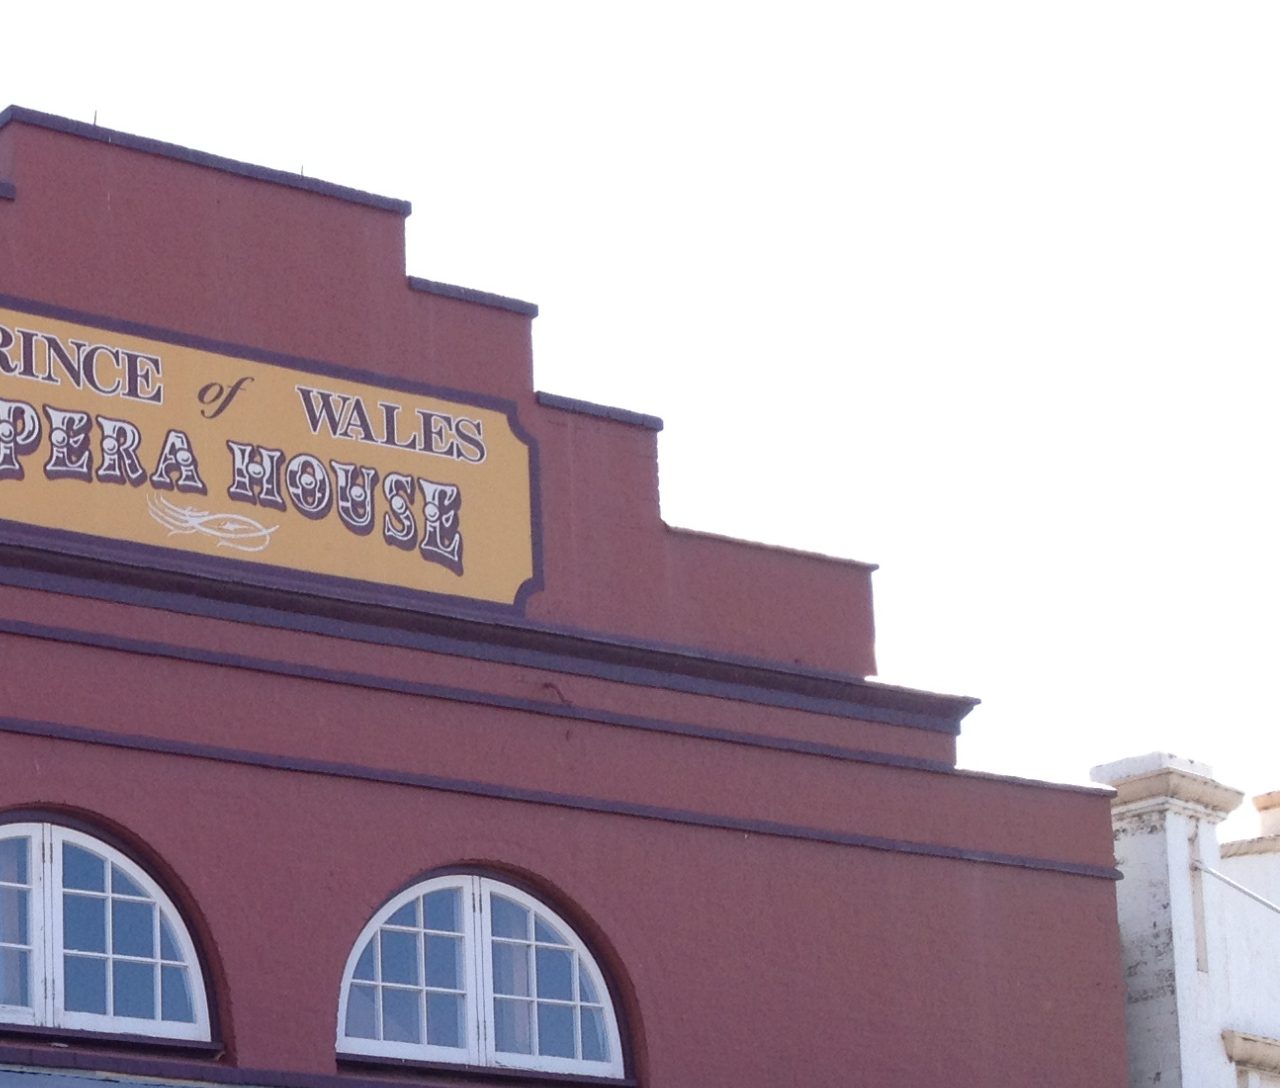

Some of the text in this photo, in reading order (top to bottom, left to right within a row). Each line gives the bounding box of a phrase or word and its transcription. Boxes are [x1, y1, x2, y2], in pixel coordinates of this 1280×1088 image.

[197, 375, 253, 419] of
[295, 384, 487, 464] WALES
[226, 438, 464, 575] HOUSE
